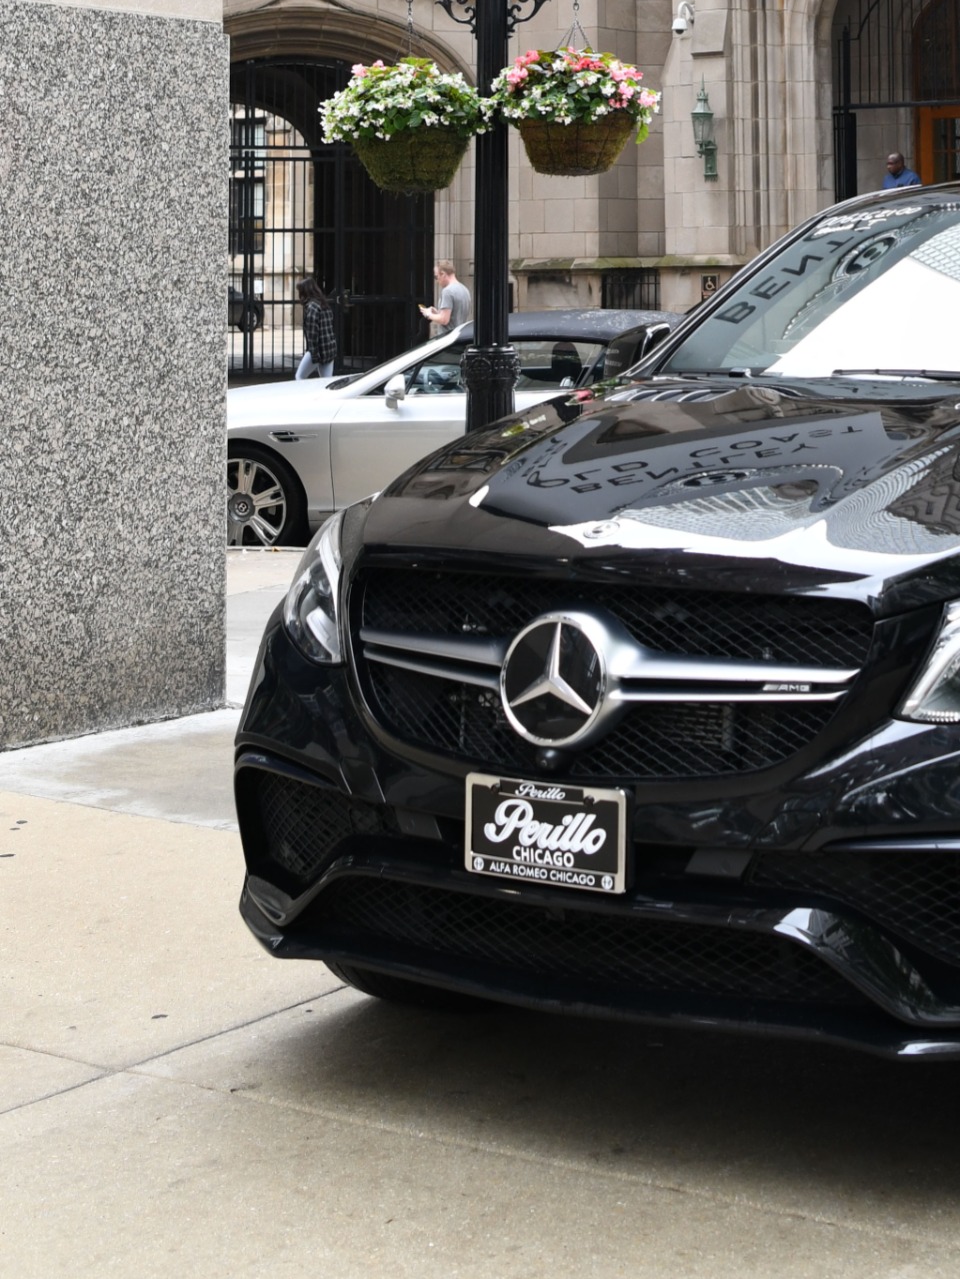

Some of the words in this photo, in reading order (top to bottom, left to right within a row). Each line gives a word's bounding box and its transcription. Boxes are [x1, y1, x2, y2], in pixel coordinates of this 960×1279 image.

[515, 782, 566, 800] Perillo
[483, 798, 607, 855] Perillo
[512, 845, 575, 868] CHICAGO
[489, 861, 511, 875] ALFA
[512, 864, 548, 880] ROMEO
[549, 868, 596, 887] CHICAGO
